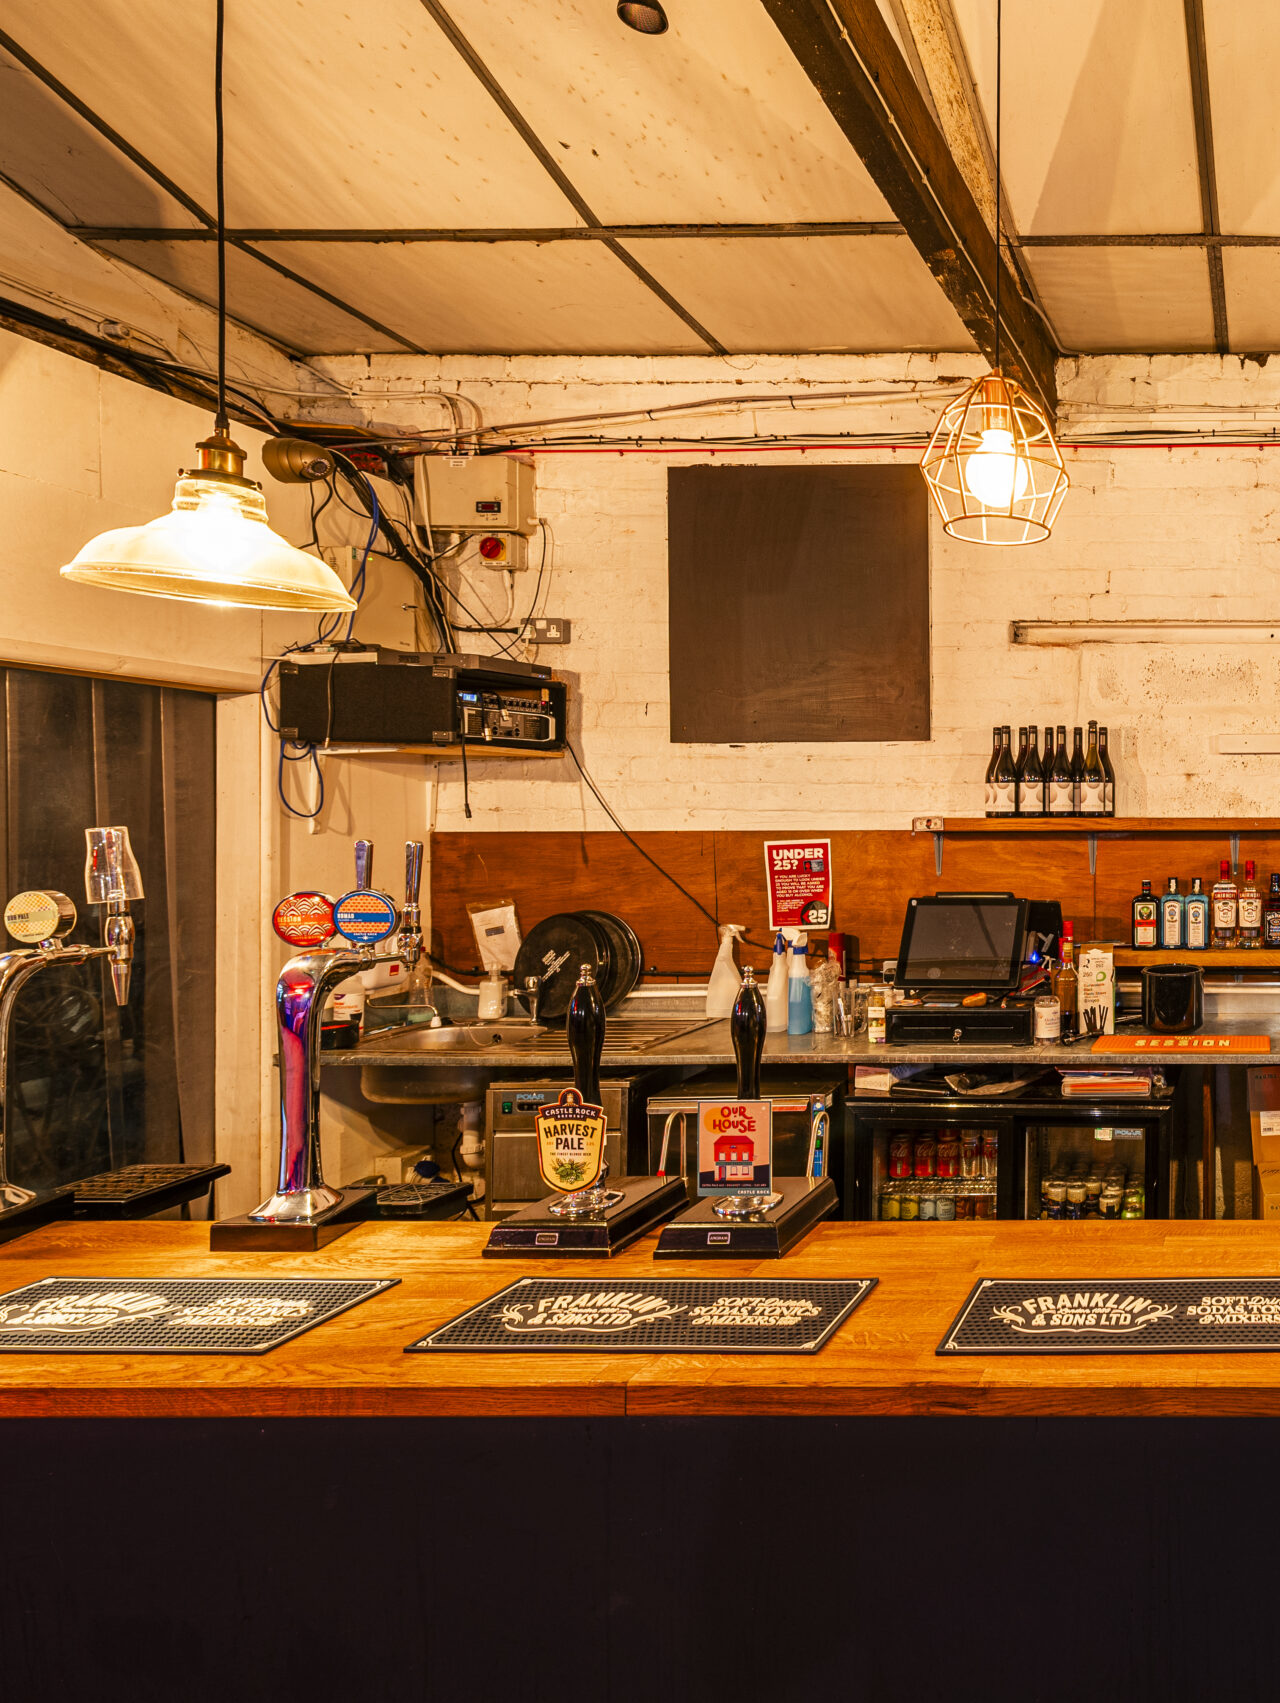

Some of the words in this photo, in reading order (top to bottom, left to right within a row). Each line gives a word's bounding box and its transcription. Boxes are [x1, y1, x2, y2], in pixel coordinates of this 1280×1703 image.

[772, 848, 824, 860] UNDER
[773, 860, 799, 871] 25?
[808, 909, 828, 923] 25
[516, 1093, 545, 1101] POLAR
[545, 1108, 574, 1117] CASTLE
[575, 1107, 597, 1117] ROCK
[720, 1106, 753, 1120] OUR
[543, 1123, 598, 1139] HARVEST
[713, 1119, 757, 1134] HOUSE
[555, 1138, 585, 1150] PALE
[537, 1292, 668, 1314] FRANKLIN
[713, 1297, 766, 1307] SOFT
[1022, 1292, 1152, 1315] FRANKLIN
[1201, 1296, 1249, 1306] SOFT
[753, 1306, 823, 1317] TONICS
[527, 1312, 548, 1325] &
[545, 1313, 595, 1326] SONS
[593, 1313, 633, 1326] LTD
[705, 1315, 779, 1326] MIXERS
[1031, 1313, 1047, 1326] &
[1049, 1313, 1098, 1326] SONS
[1099, 1313, 1132, 1326] LTD
